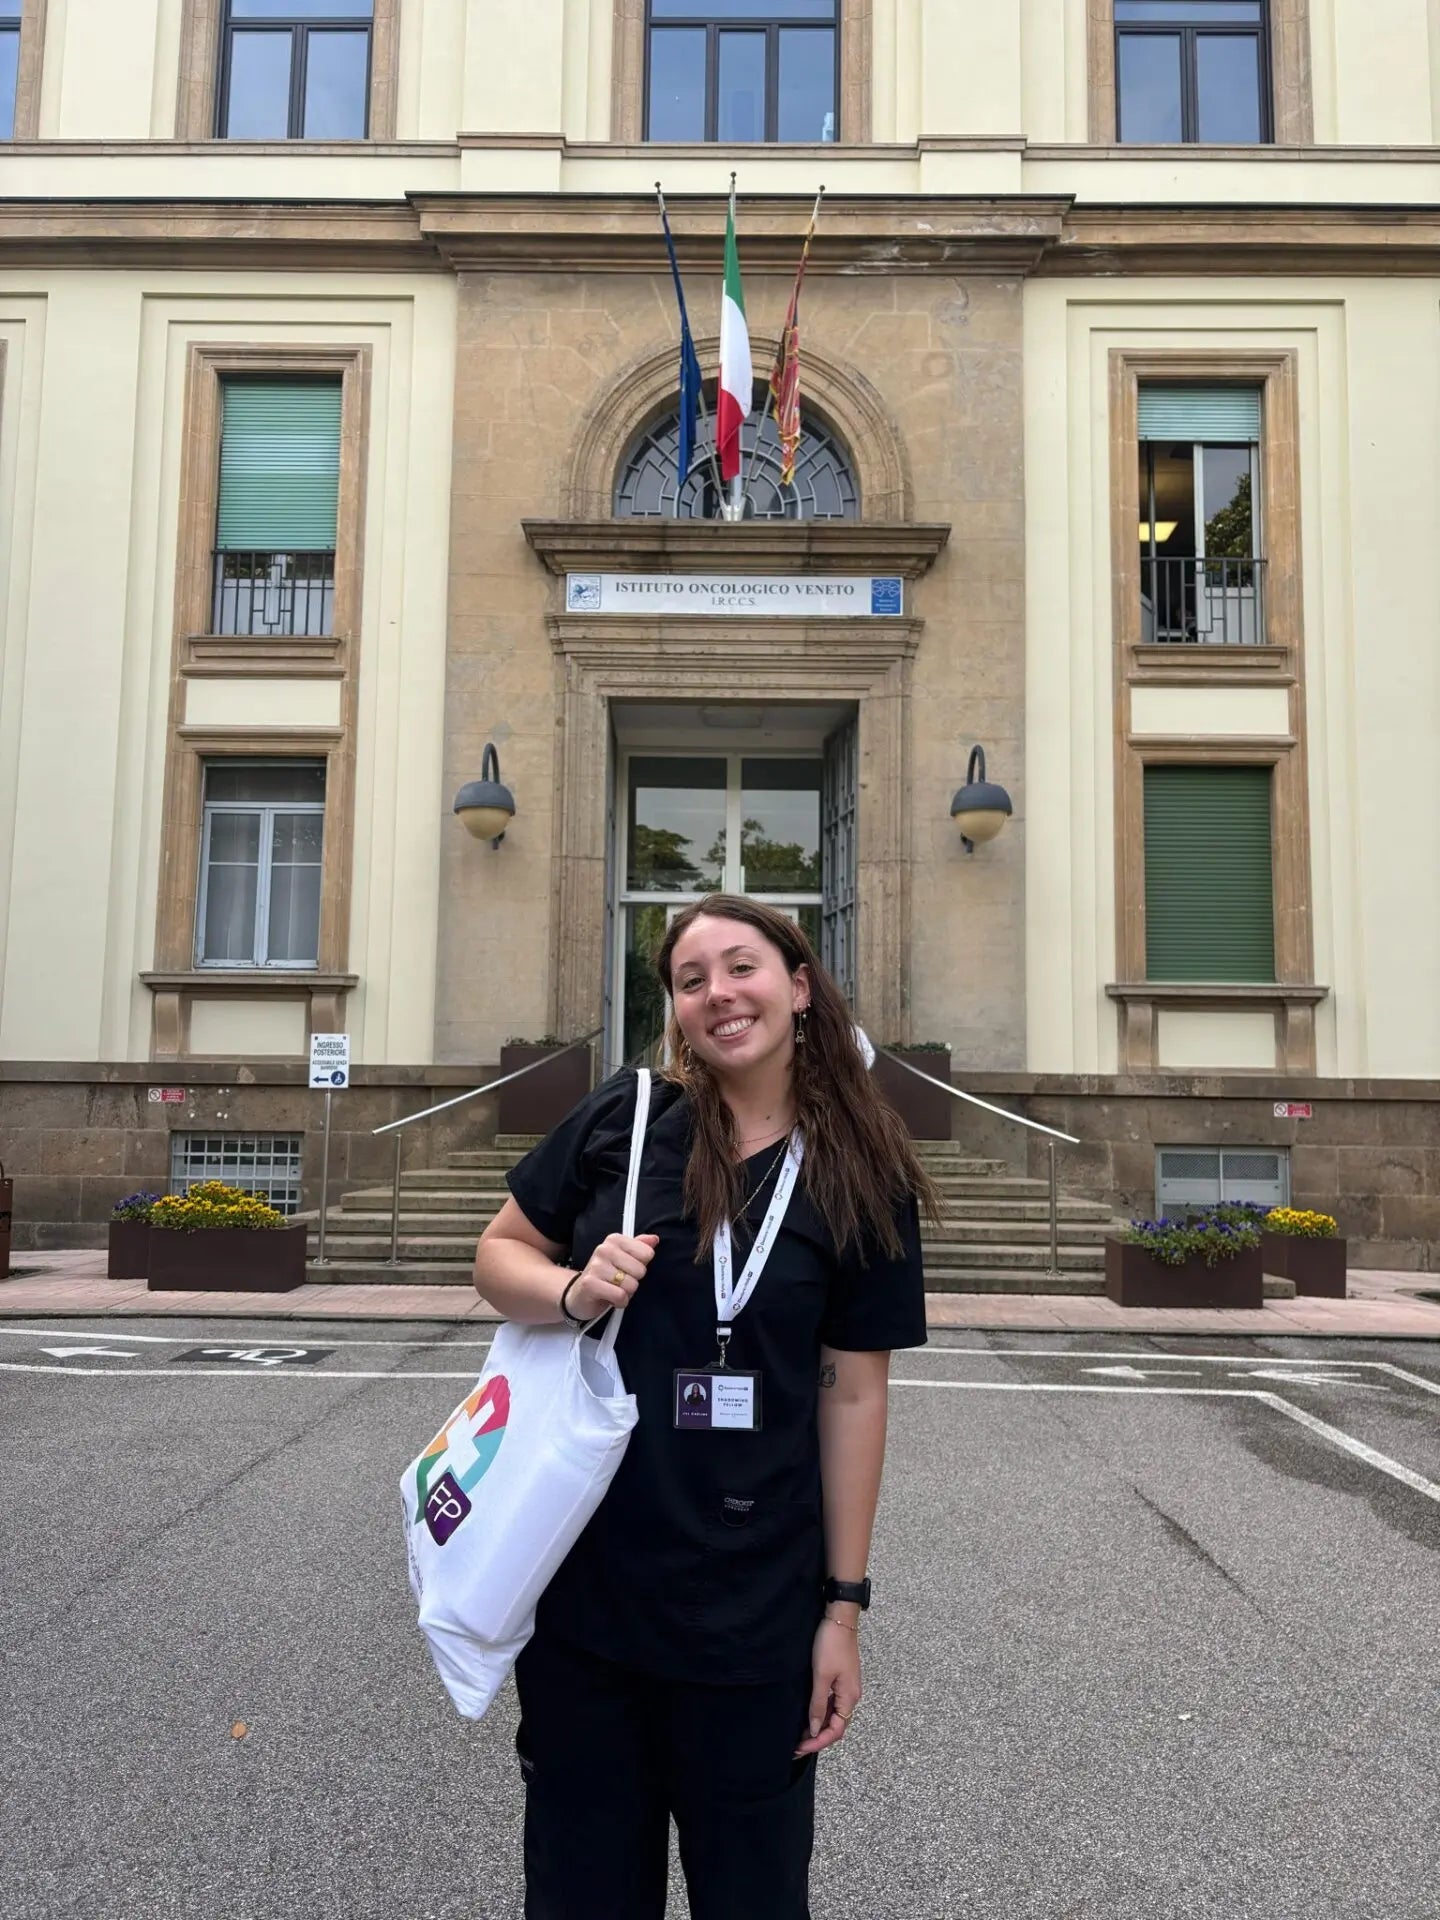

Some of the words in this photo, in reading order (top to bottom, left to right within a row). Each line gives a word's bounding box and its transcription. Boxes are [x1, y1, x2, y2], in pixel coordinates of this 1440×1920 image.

[615, 581, 684, 594] ISTITUTO
[689, 582, 790, 595] ONCOLOGICO
[795, 584, 854, 596] VENETO
[711, 596, 757, 607] I.R.C.C.S.
[316, 1041, 344, 1049] INGRESSO
